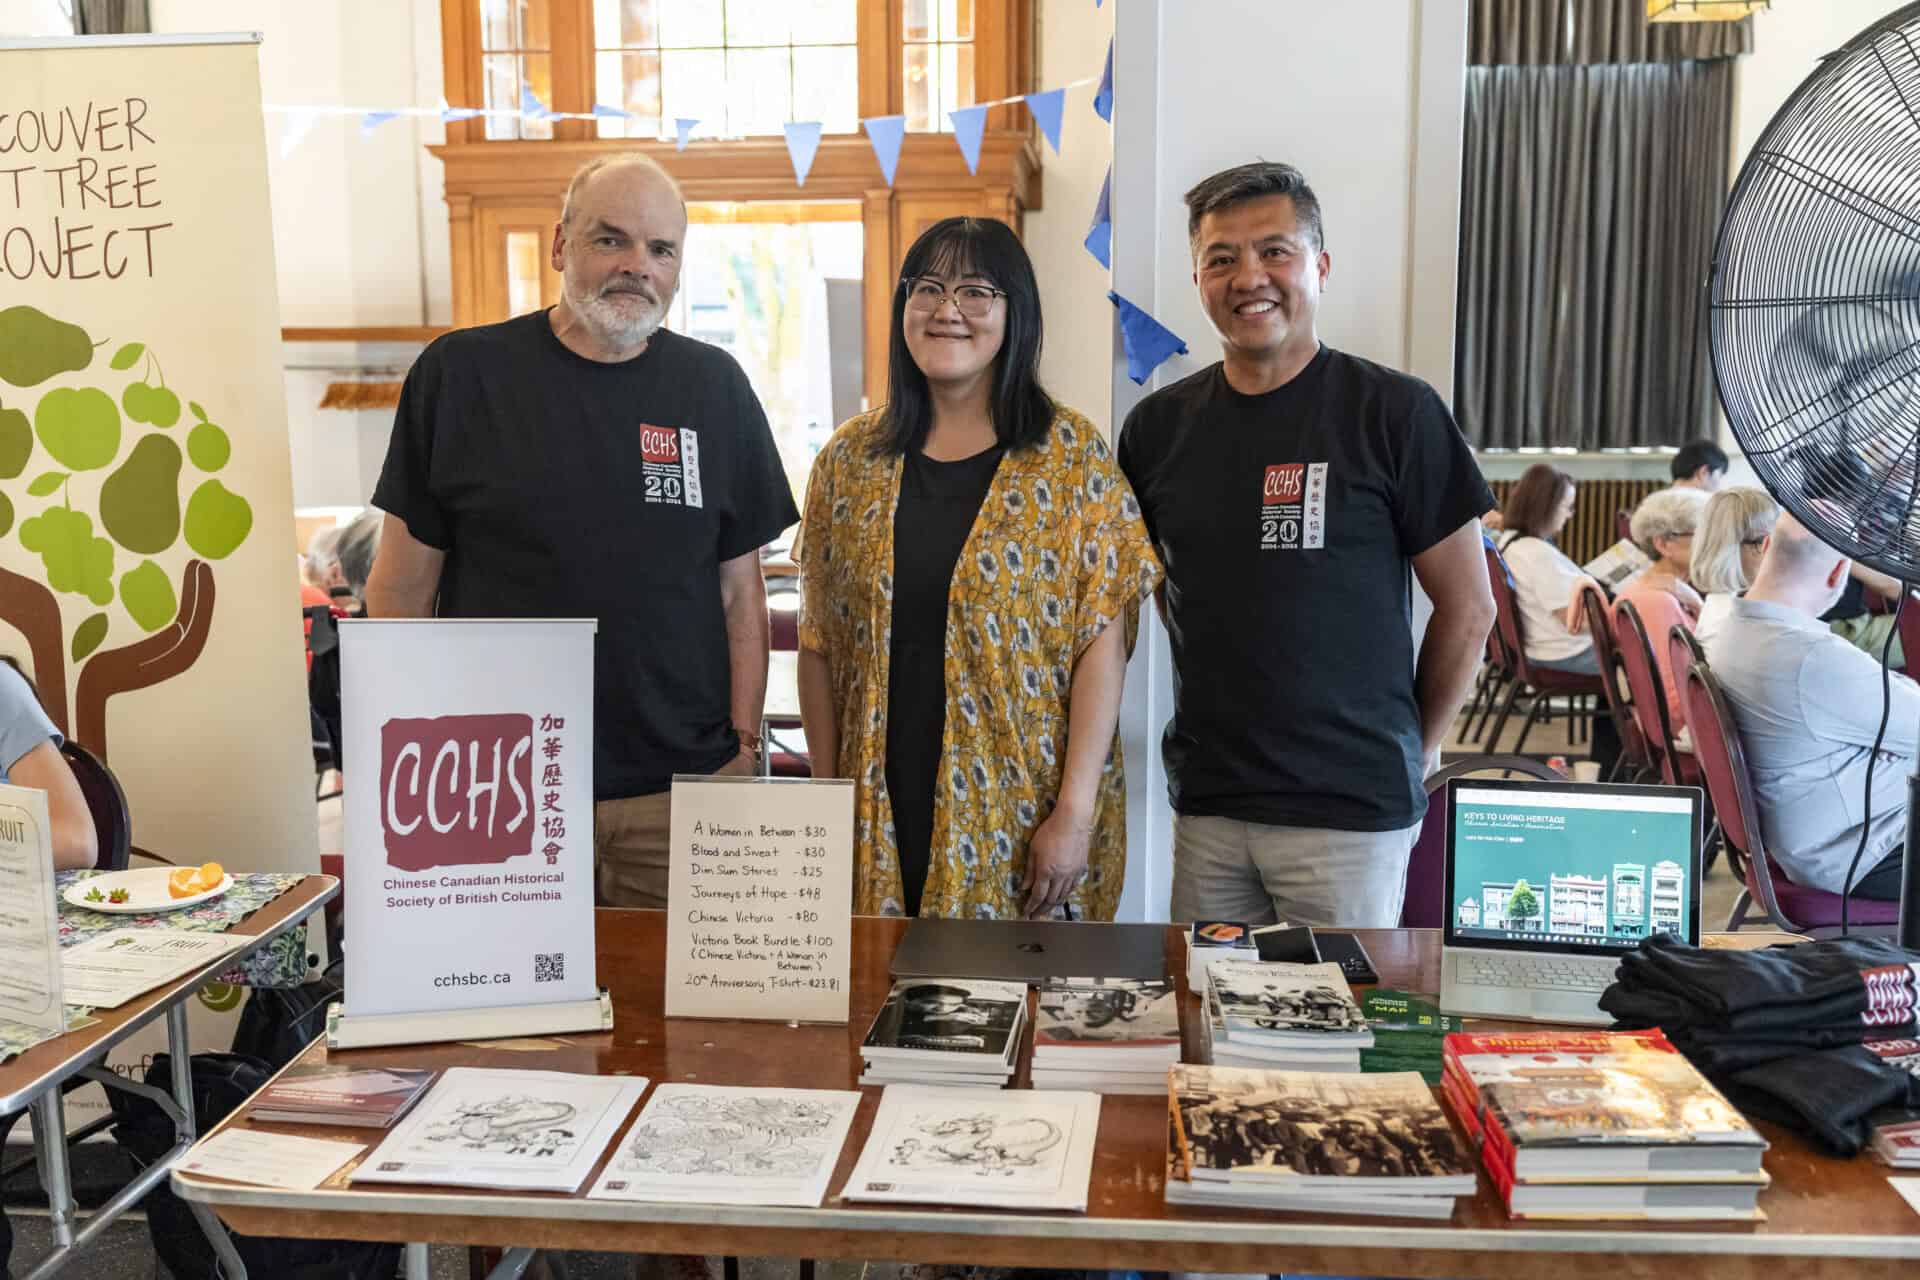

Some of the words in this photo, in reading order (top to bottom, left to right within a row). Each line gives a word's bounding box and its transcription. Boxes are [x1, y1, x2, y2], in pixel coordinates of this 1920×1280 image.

[44, 157, 162, 210] TREE
[0, 215, 174, 281] OJECT
[641, 429, 678, 457] CCHS
[645, 476, 681, 498] 20
[1264, 469, 1304, 497] CCHS
[1262, 520, 1298, 543] 20
[387, 735, 532, 838] CCHS
[540, 713, 565, 865] 加華歷史協會
[1464, 812, 1485, 821] KEYS
[1487, 813, 1497, 821] TO
[1499, 814, 1525, 822] LIVING
[1526, 815, 1566, 824] HERITAGE
[694, 819, 703, 836] A
[744, 829, 754, 838] in
[760, 825, 796, 837] Between
[691, 843, 719, 857] Blood
[722, 847, 741, 857] and
[744, 846, 779, 858] Sweat
[691, 863, 714, 875] Dim
[717, 864, 739, 876] Sum
[742, 865, 778, 876] Stories
[383, 878, 437, 890] Chinese
[440, 875, 500, 888] Canadian
[504, 872, 565, 885] Historical
[386, 896, 435, 909] Society
[439, 894, 451, 906] of
[455, 893, 498, 905] British
[501, 890, 562, 903] Columbia
[691, 884, 741, 903] Journeys
[745, 884, 757, 898] of
[762, 885, 788, 903] Hope
[688, 910, 729, 924] Chinese
[736, 911, 774, 923] Victoria
[691, 932, 729, 946] Victoria
[733, 933, 759, 945] Book
[763, 933, 801, 946] Bundle
[777, 950, 783, 959] A
[817, 951, 828, 961] in
[434, 973, 511, 989] cchsbc.ca
[685, 974, 709, 987] 20th
[710, 974, 765, 993] Anniversary
